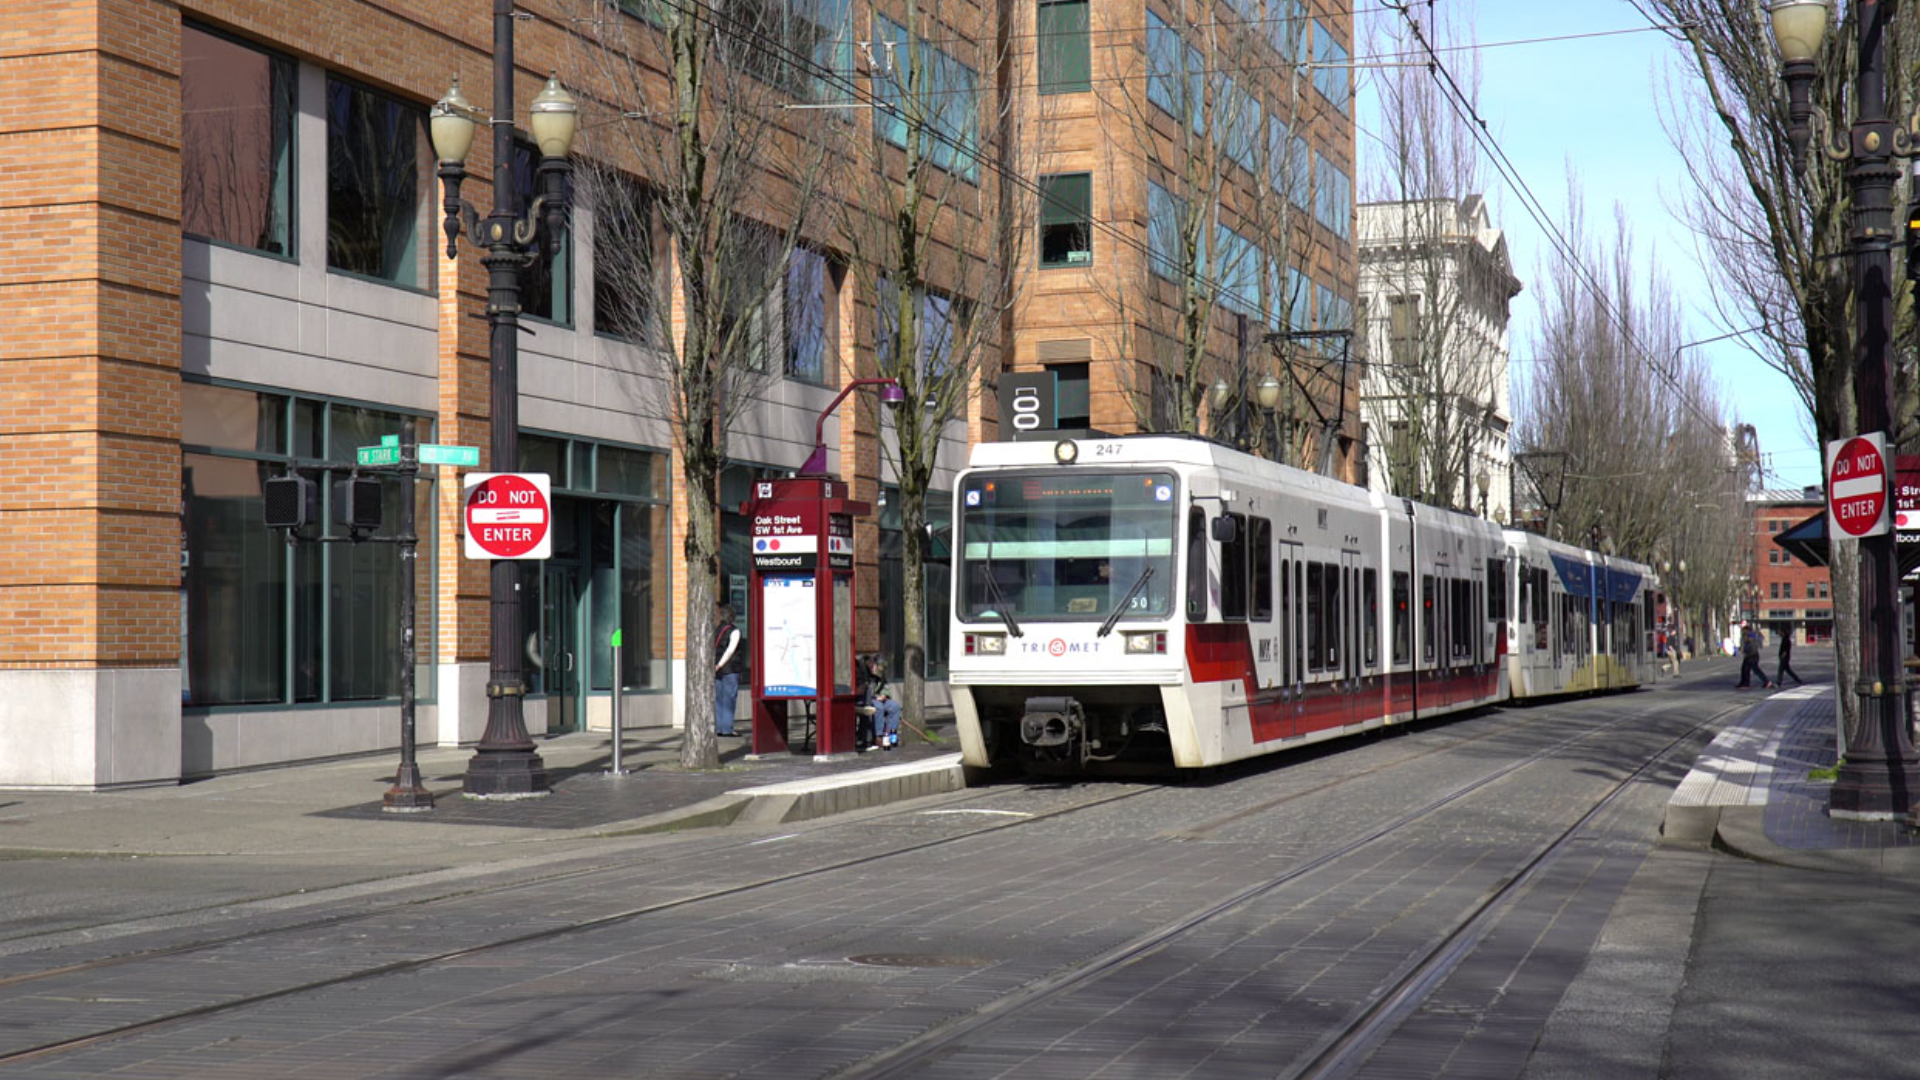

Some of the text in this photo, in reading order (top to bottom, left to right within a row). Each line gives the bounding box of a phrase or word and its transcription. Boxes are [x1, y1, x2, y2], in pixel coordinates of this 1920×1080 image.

[1096, 444, 1123, 456] 247
[1836, 453, 1877, 476] DO NOT
[1901, 485, 1920, 496] Str
[478, 490, 537, 504] DO NOT
[1897, 498, 1915, 509] 1st
[1841, 499, 1876, 520] ENTER
[755, 514, 801, 524] Oak Street
[483, 527, 532, 542] ENTER
[755, 525, 803, 535] SW 1st Ave
[755, 556, 802, 566] Westbound
